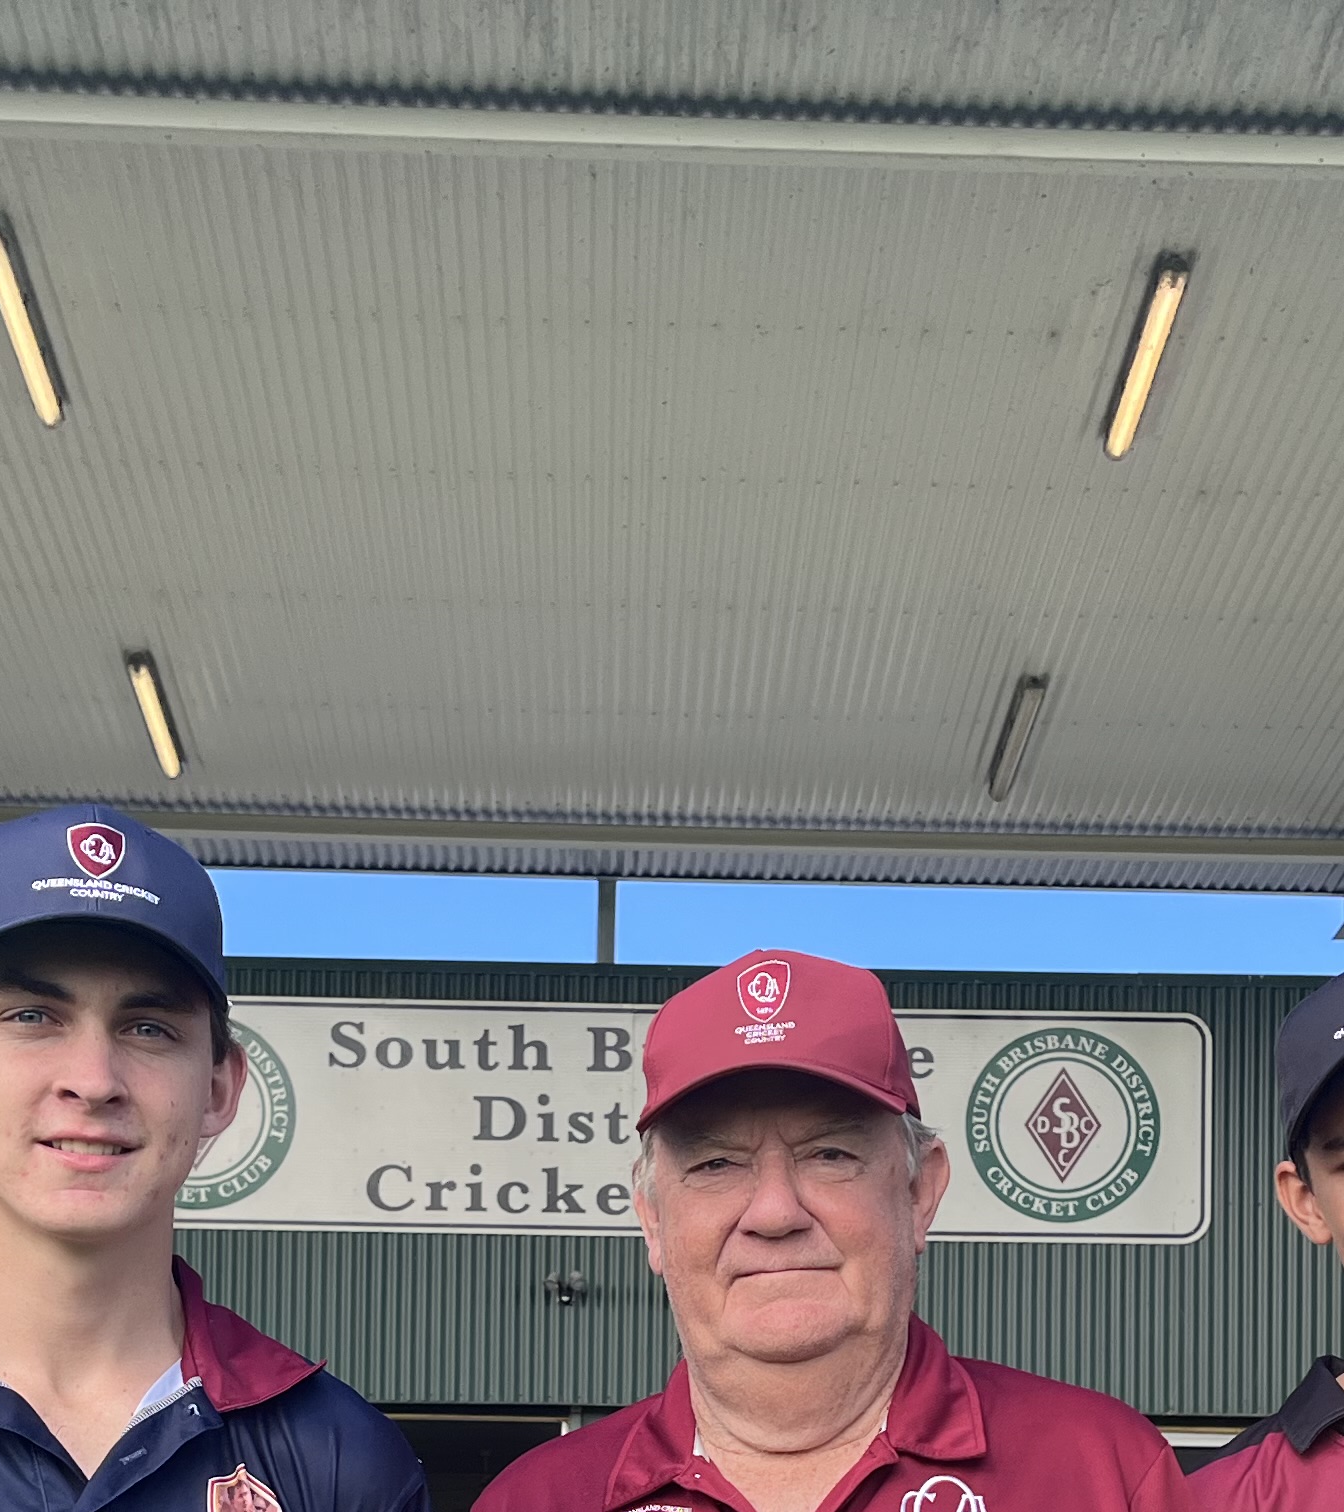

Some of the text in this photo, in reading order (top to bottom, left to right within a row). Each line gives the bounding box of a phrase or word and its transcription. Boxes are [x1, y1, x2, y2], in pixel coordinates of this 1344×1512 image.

[31, 877, 161, 905] QUEENSLAND CRICKET
[70, 888, 124, 902] COUNTRY
[328, 1021, 553, 1071] South
[246, 1040, 289, 1143] DISTRICT
[972, 1073, 1001, 1153] SOUTH
[996, 1034, 1109, 1073] BRISBANE
[1111, 1055, 1155, 1156] DISTRICT
[473, 1094, 630, 1144] Dist
[218, 1154, 272, 1198] CLUB
[366, 1163, 631, 1215] Cricke
[987, 1166, 1139, 1216] CRICKET CLUB
